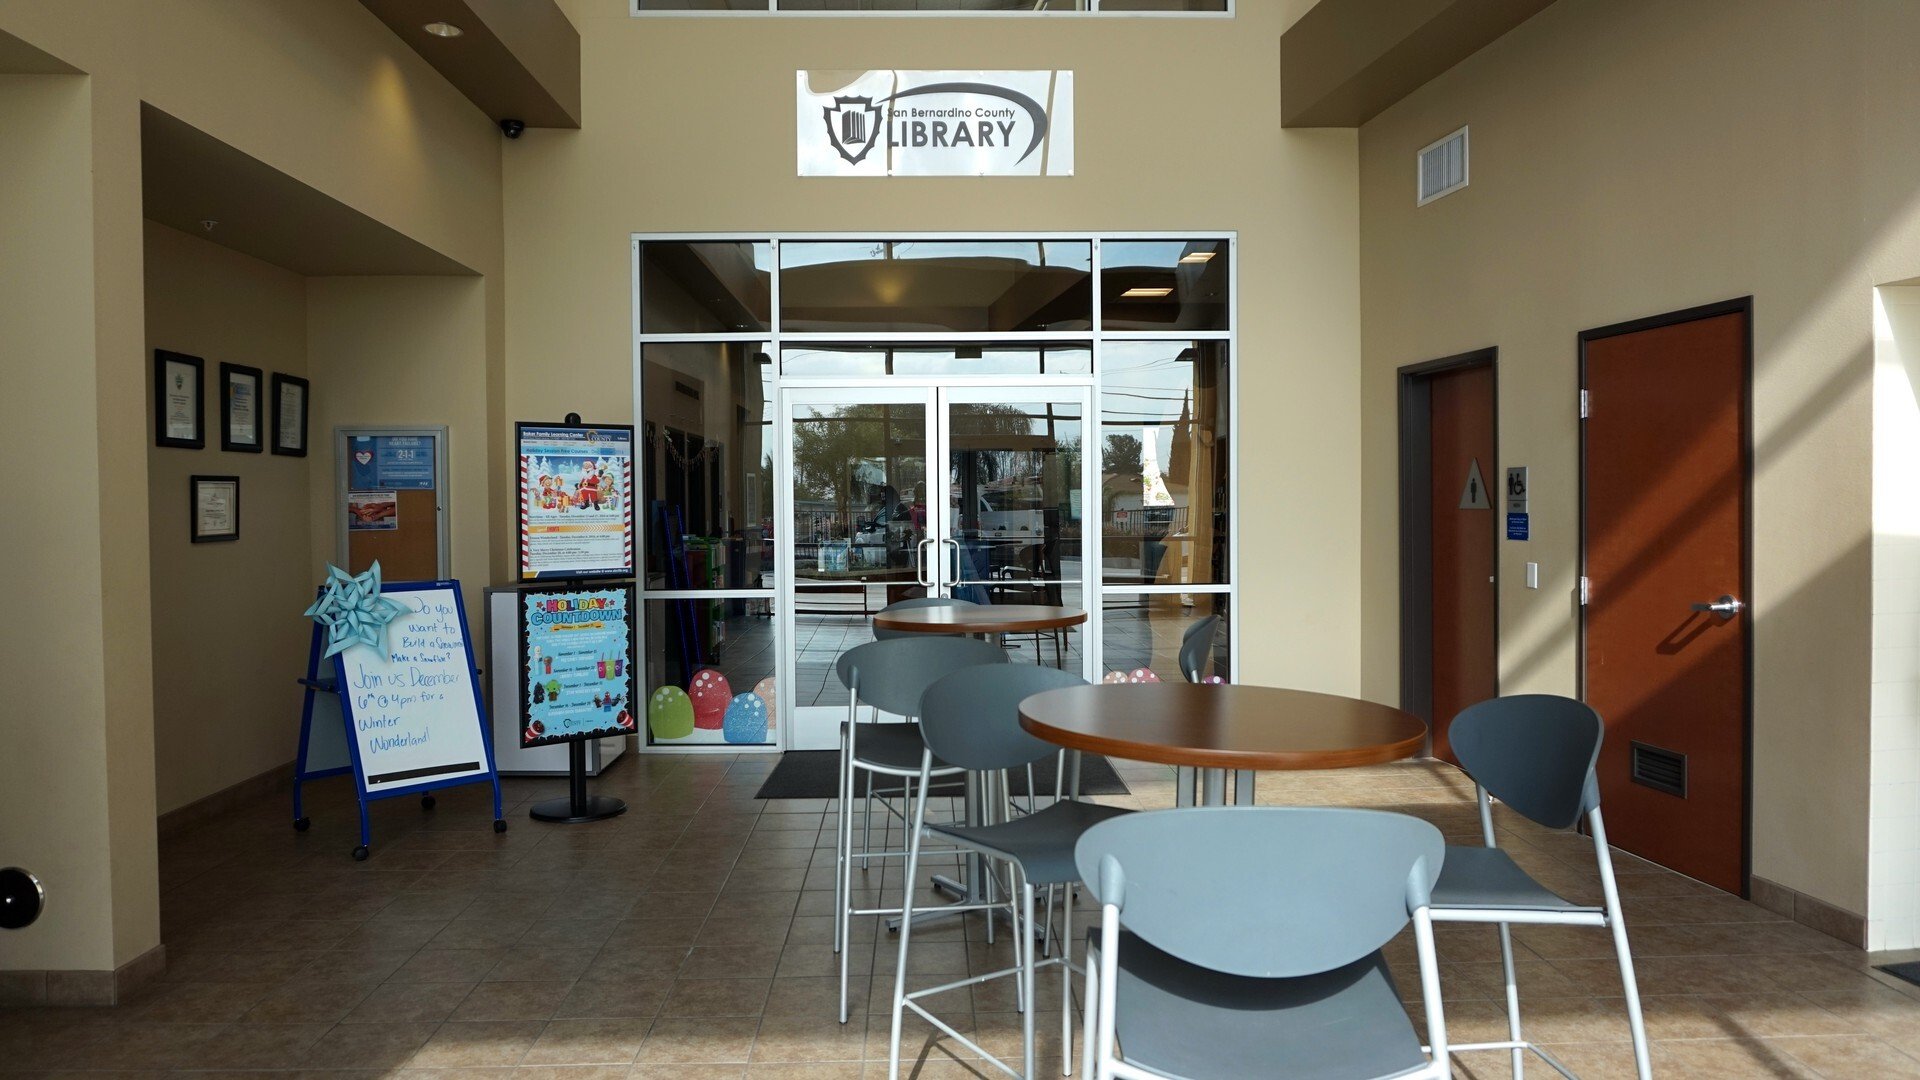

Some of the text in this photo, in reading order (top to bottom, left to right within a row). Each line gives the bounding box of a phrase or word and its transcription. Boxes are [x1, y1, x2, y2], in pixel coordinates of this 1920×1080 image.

[911, 107, 972, 118] Bernardino
[975, 107, 1015, 120] County
[887, 120, 1016, 147] LIBRARY
[435, 604, 454, 623] you
[546, 597, 607, 613] HOLIDAY
[531, 608, 623, 626] COUNTDOWN
[443, 622, 456, 635] to
[353, 663, 383, 690] Join
[410, 666, 460, 687] December
[377, 694, 389, 709] @
[420, 691, 434, 702] for
[358, 714, 401, 732] Winter
